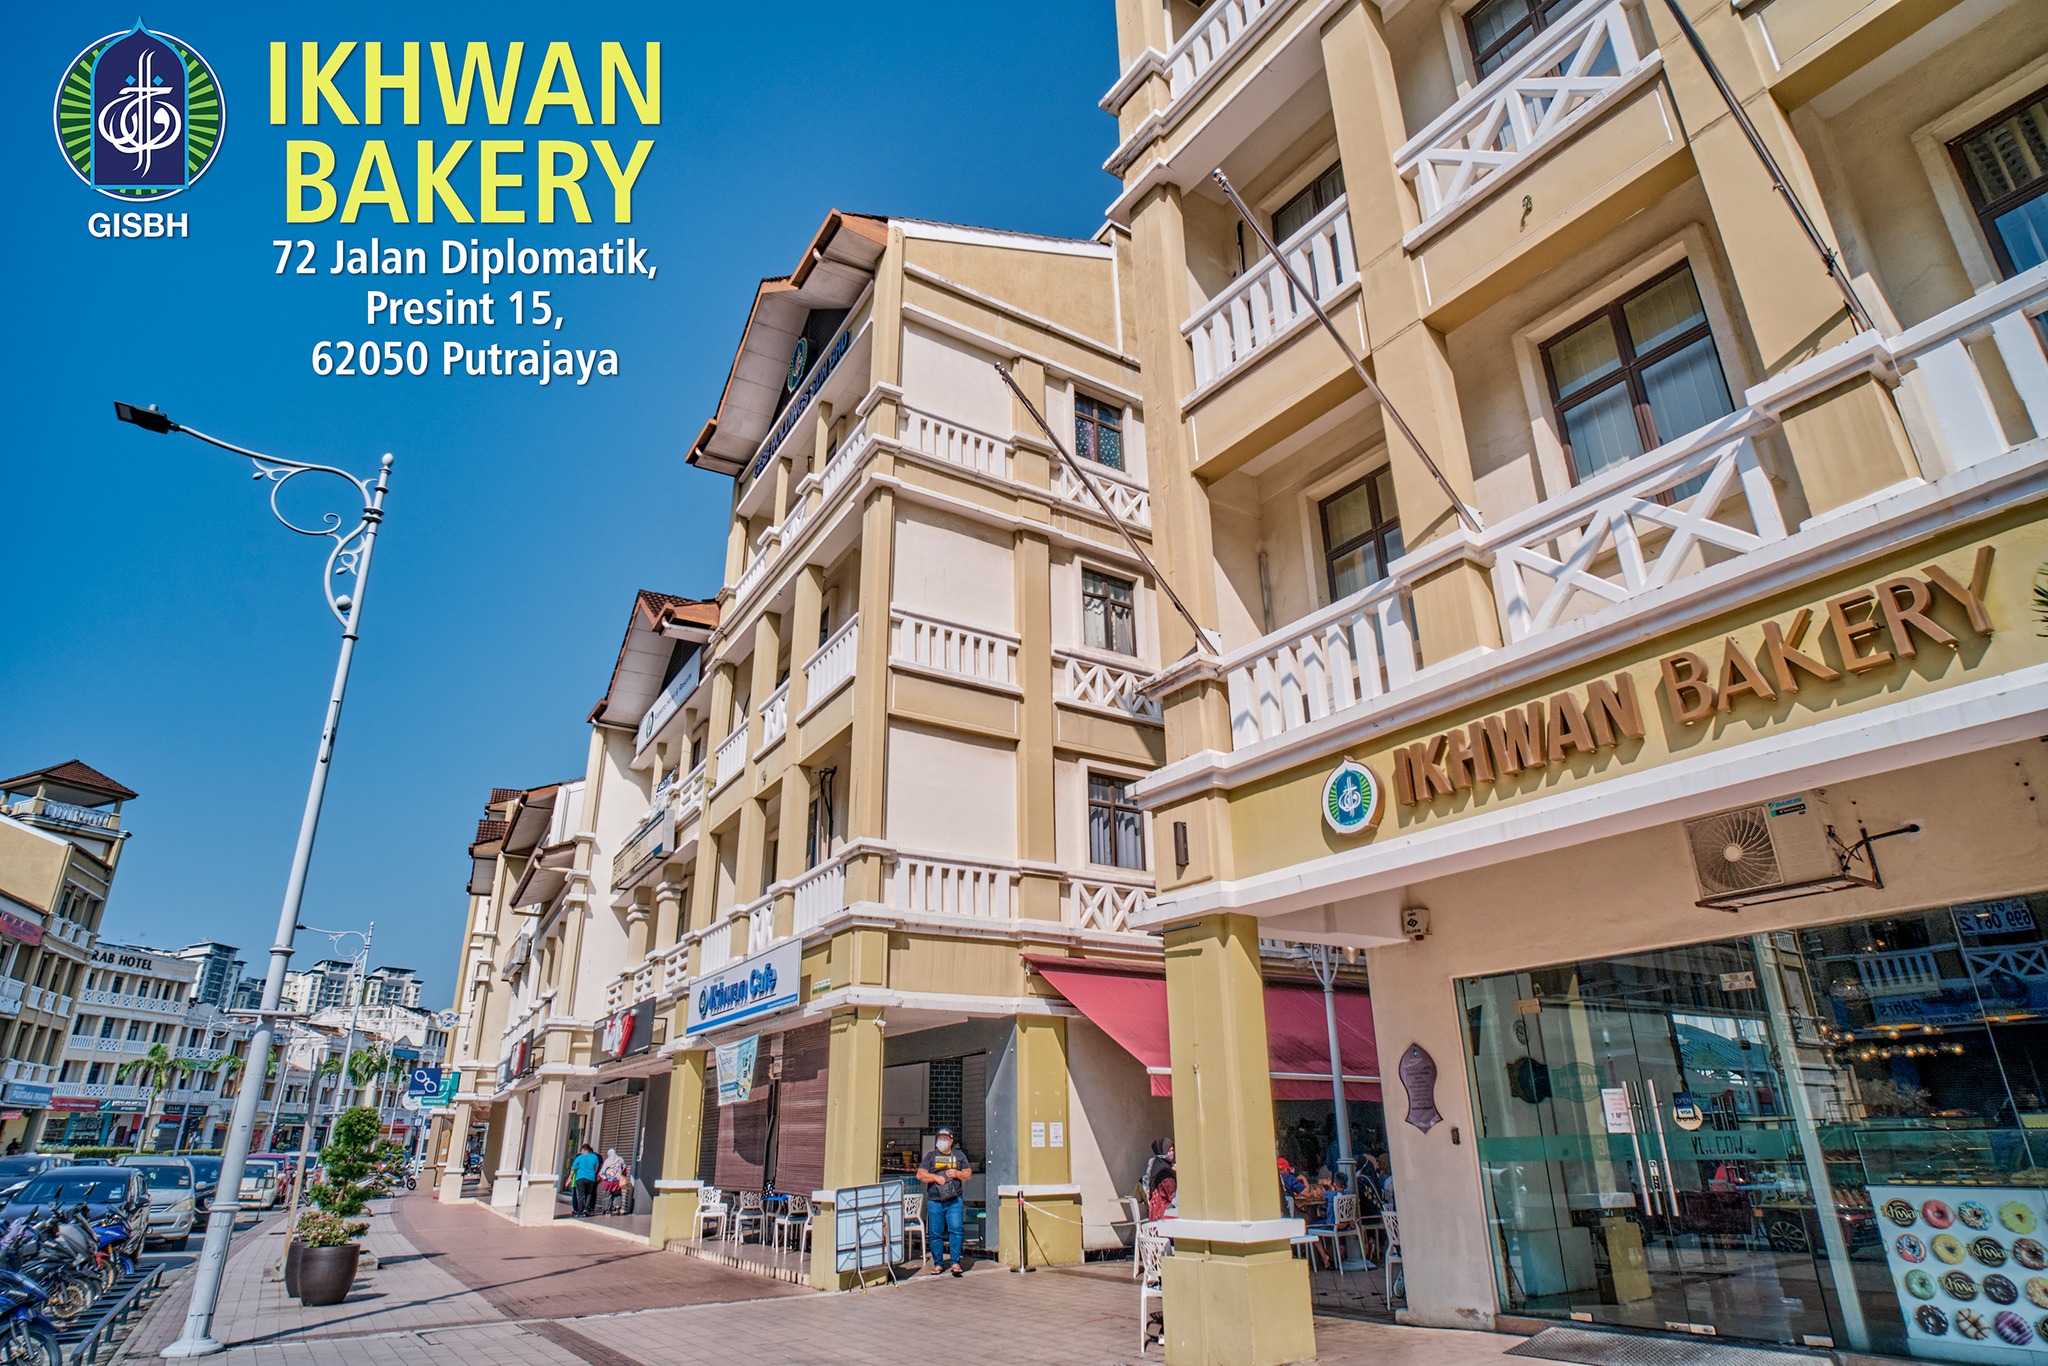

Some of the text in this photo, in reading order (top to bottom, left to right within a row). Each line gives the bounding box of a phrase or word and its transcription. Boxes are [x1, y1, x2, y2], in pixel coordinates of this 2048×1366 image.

[1393, 544, 1996, 806] IKHWAN BAKERY
[118, 955, 153, 971] HOTEL
[1675, 1097, 1692, 1105] OPEN
